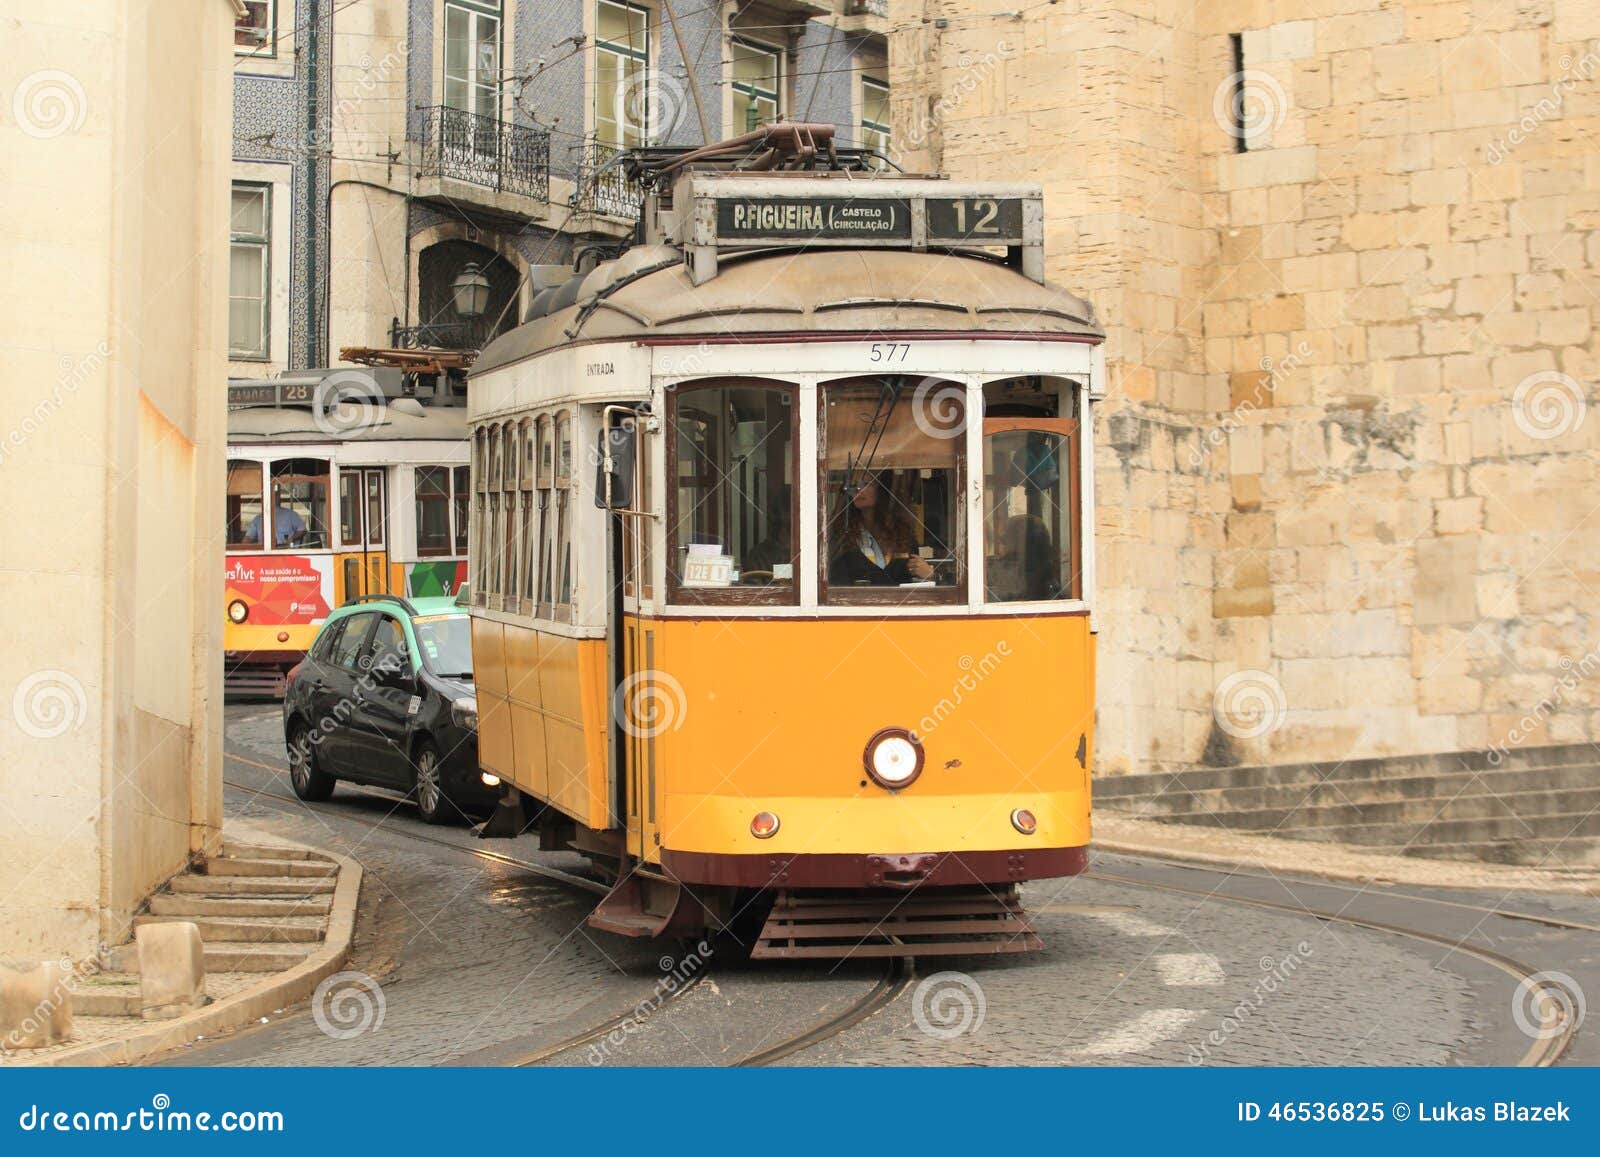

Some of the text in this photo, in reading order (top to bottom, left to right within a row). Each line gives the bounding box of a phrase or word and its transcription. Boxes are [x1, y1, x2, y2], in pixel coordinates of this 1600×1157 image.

[842, 208, 882, 218] CASTELO
[952, 200, 1000, 233] 12
[834, 219, 889, 231] CIRCULAÇÃO
[870, 343, 911, 362] 577
[586, 362, 615, 377] ENTRADA
[286, 384, 307, 400] 28
